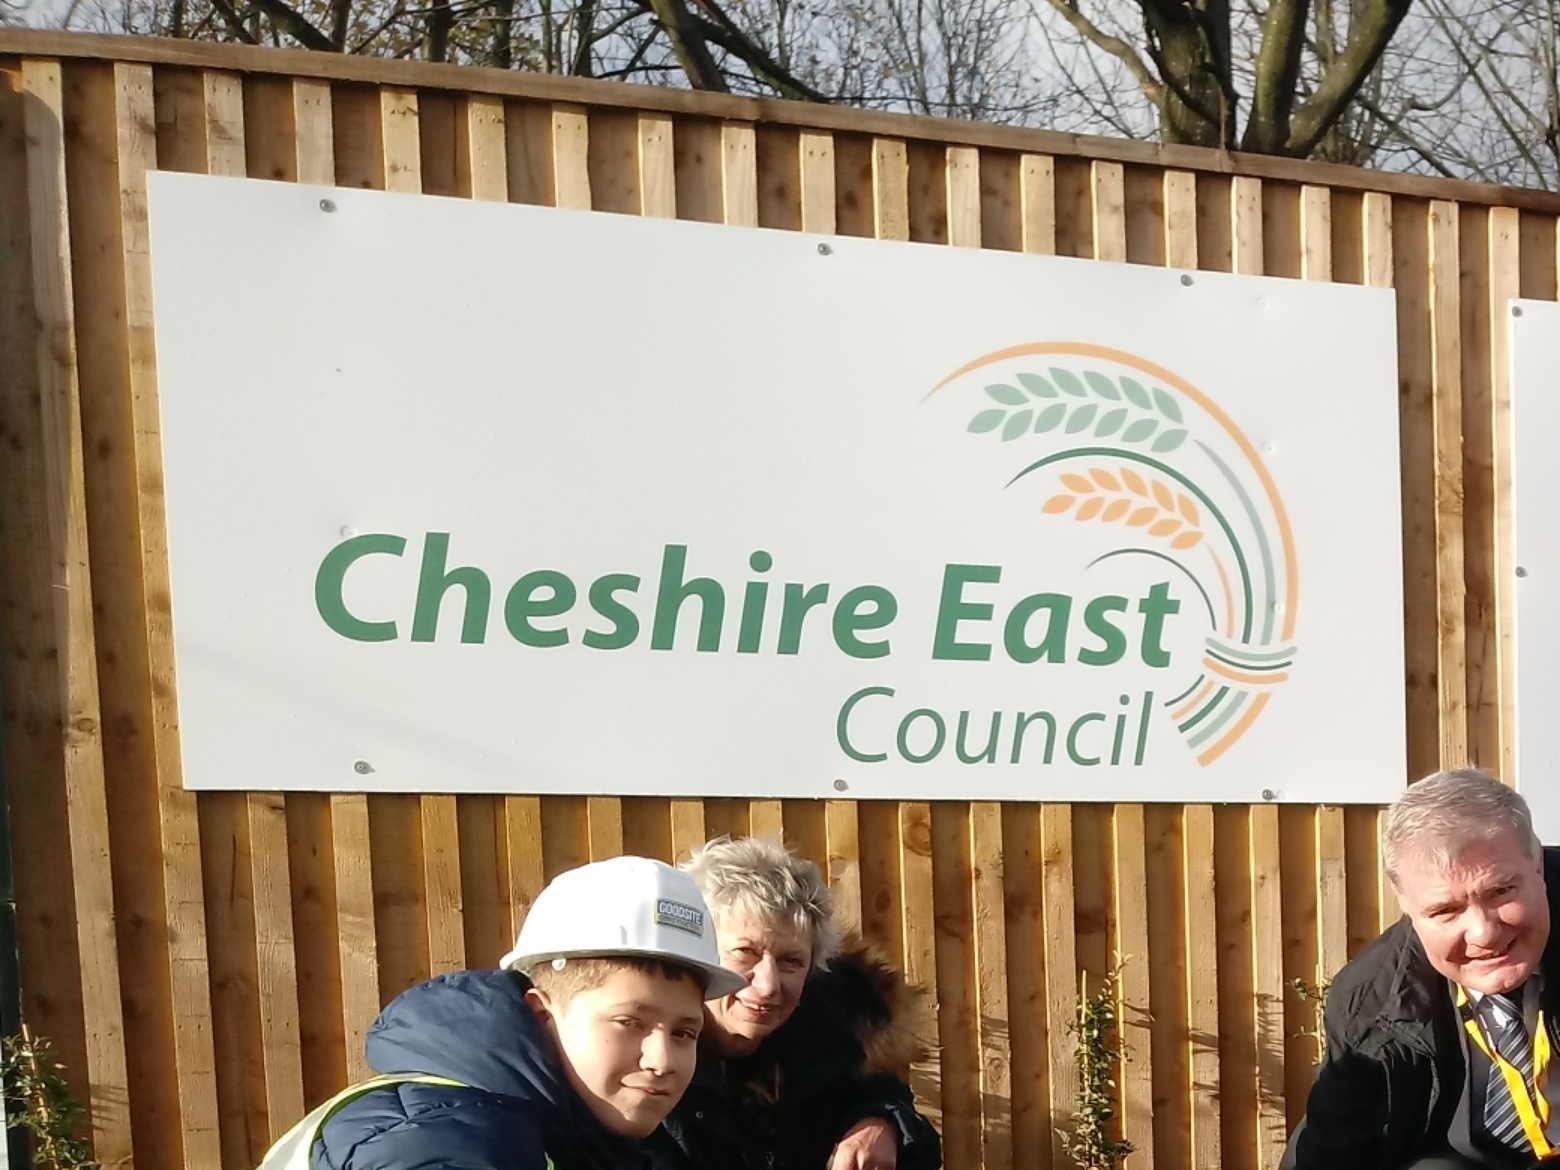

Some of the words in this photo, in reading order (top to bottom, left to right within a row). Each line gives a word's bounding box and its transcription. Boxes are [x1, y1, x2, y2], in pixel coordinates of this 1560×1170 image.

[316, 532, 898, 658] Cheshire
[932, 563, 1181, 667] East
[837, 686, 1154, 766] Council
